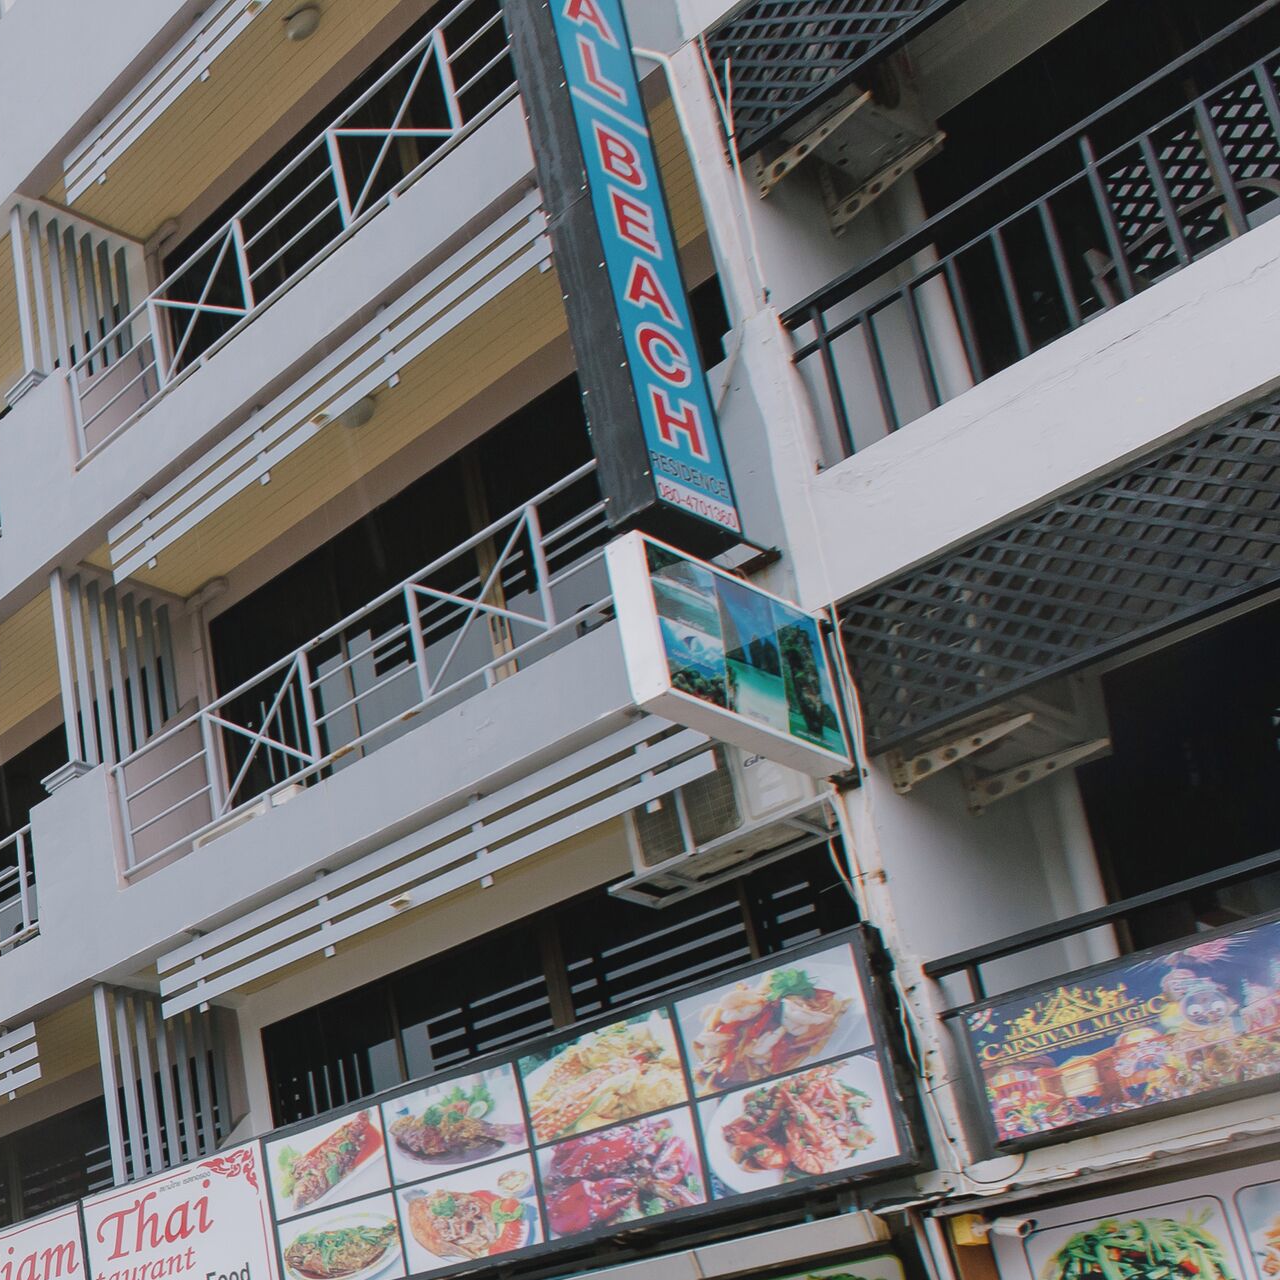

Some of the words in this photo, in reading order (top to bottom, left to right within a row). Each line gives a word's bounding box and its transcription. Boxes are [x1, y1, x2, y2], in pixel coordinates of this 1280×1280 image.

[592, 118, 711, 464] BEACH
[649, 450, 729, 499] RESIDENCE
[983, 1021, 1088, 1060] CARNIVAL
[96, 1178, 214, 1262] Thai
